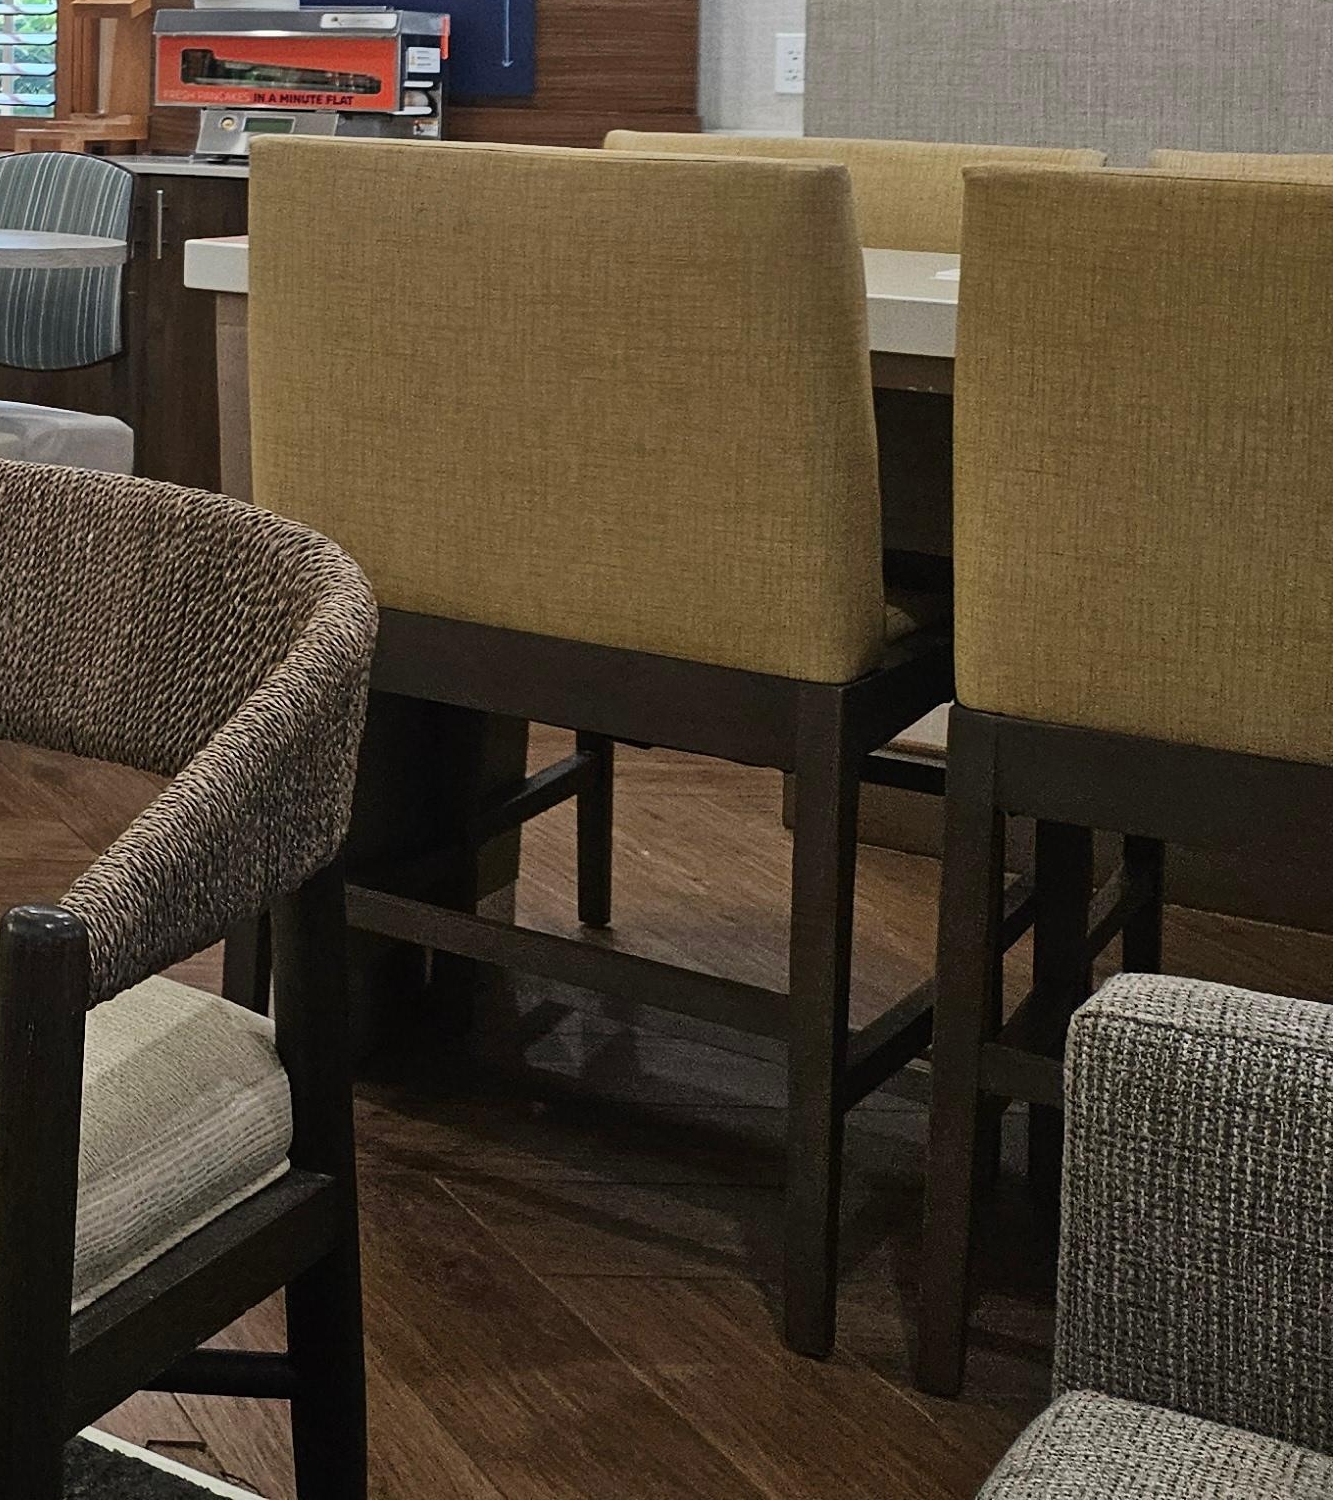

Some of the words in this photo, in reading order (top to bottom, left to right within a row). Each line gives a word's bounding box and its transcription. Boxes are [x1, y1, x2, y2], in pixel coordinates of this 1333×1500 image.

[253, 93, 266, 104] IN
[268, 94, 278, 104] A
[280, 94, 323, 105] MINUTE
[326, 95, 355, 106] FLAT
